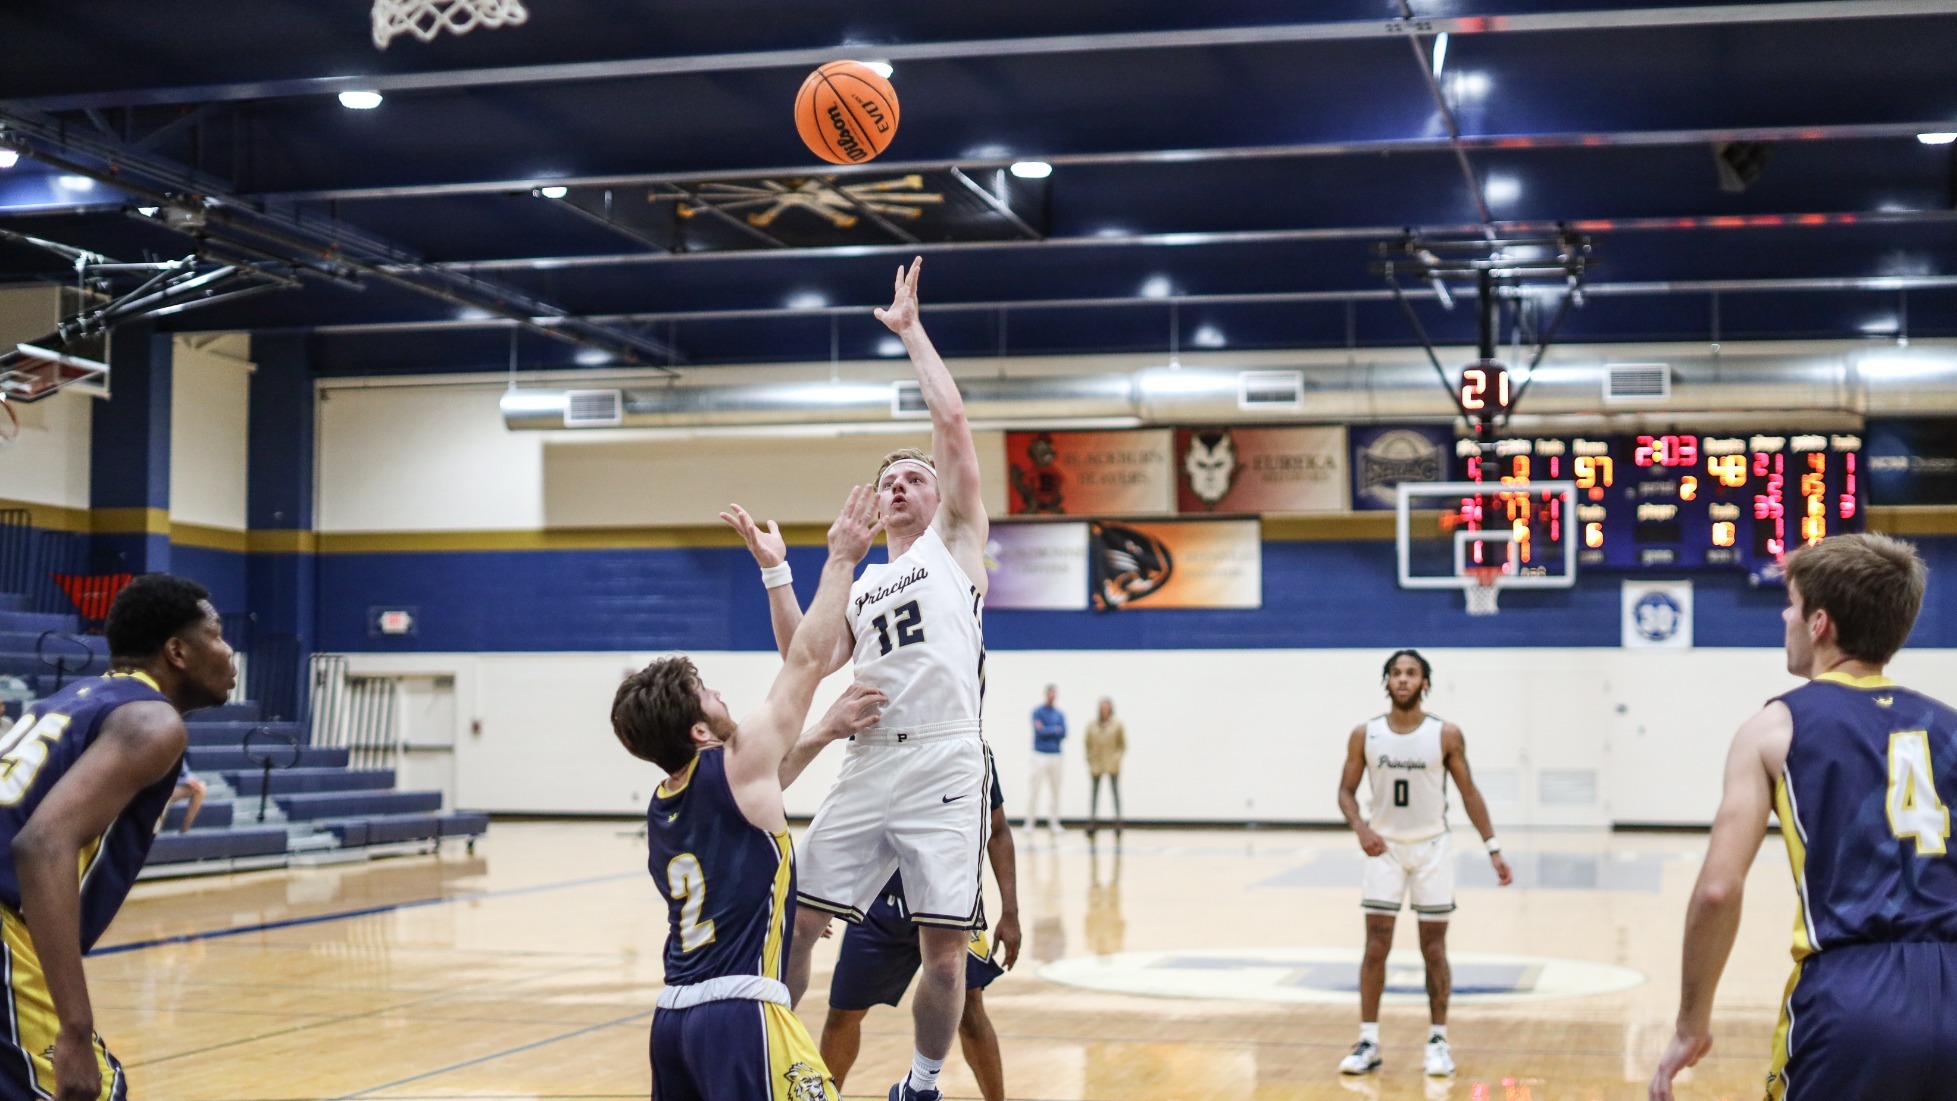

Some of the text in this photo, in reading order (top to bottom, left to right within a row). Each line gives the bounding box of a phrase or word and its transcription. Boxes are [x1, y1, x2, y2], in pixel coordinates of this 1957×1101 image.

[827, 105, 868, 162] Wilson
[1462, 369, 1509, 410] 21
[1635, 435, 1698, 467] 2:03
[1679, 475, 1698, 501] 2
[1707, 454, 1747, 487] 48
[1585, 522, 1604, 548] 6
[854, 565, 929, 617] Principia
[872, 599, 927, 657] 12
[897, 733, 908, 743] P
[0, 712, 72, 806] 5
[1377, 754, 1427, 771] Principia
[1394, 778, 1409, 808] 0
[1885, 730, 1951, 858] 4
[667, 852, 717, 953] 2
